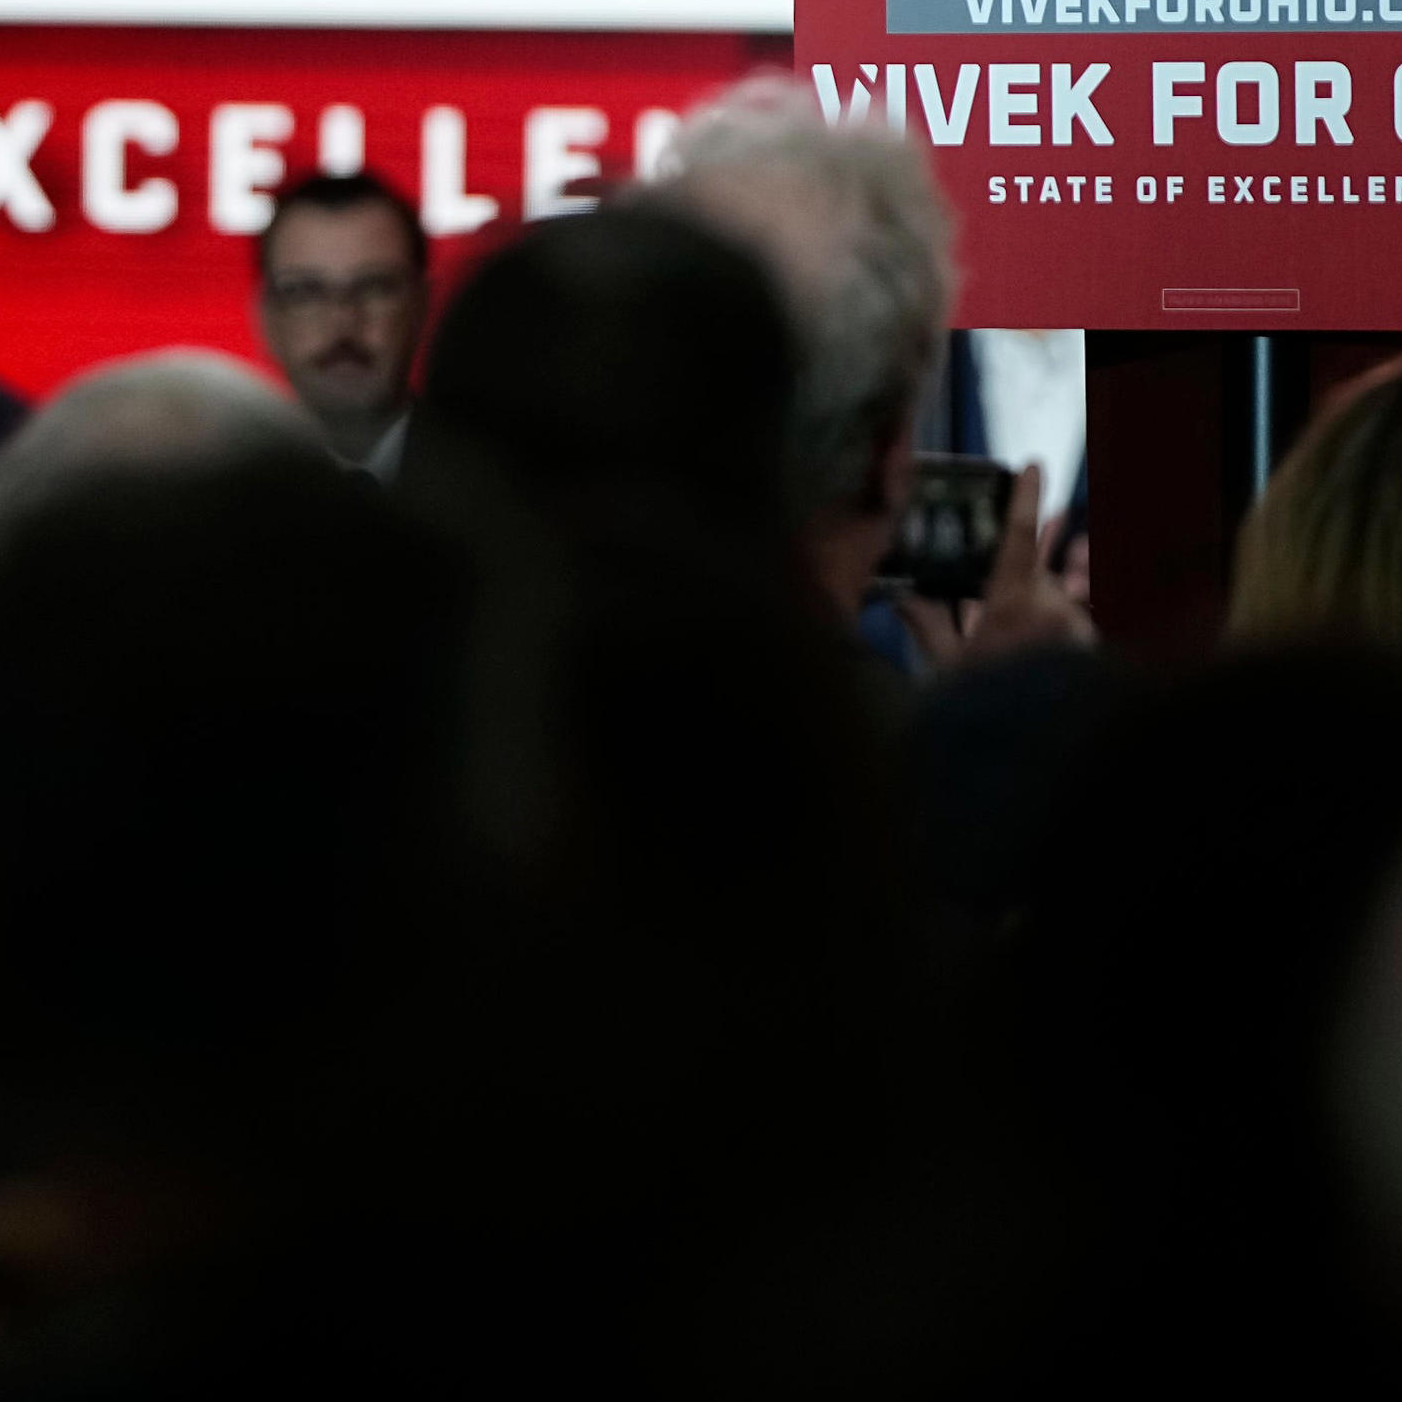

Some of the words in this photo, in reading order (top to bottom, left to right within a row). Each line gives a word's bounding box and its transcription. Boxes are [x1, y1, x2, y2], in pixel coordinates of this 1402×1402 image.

[811, 62, 1115, 146] VIVEK
[1152, 61, 1355, 146] FOR
[988, 175, 1114, 204] STATE
[1136, 175, 1185, 203] OF
